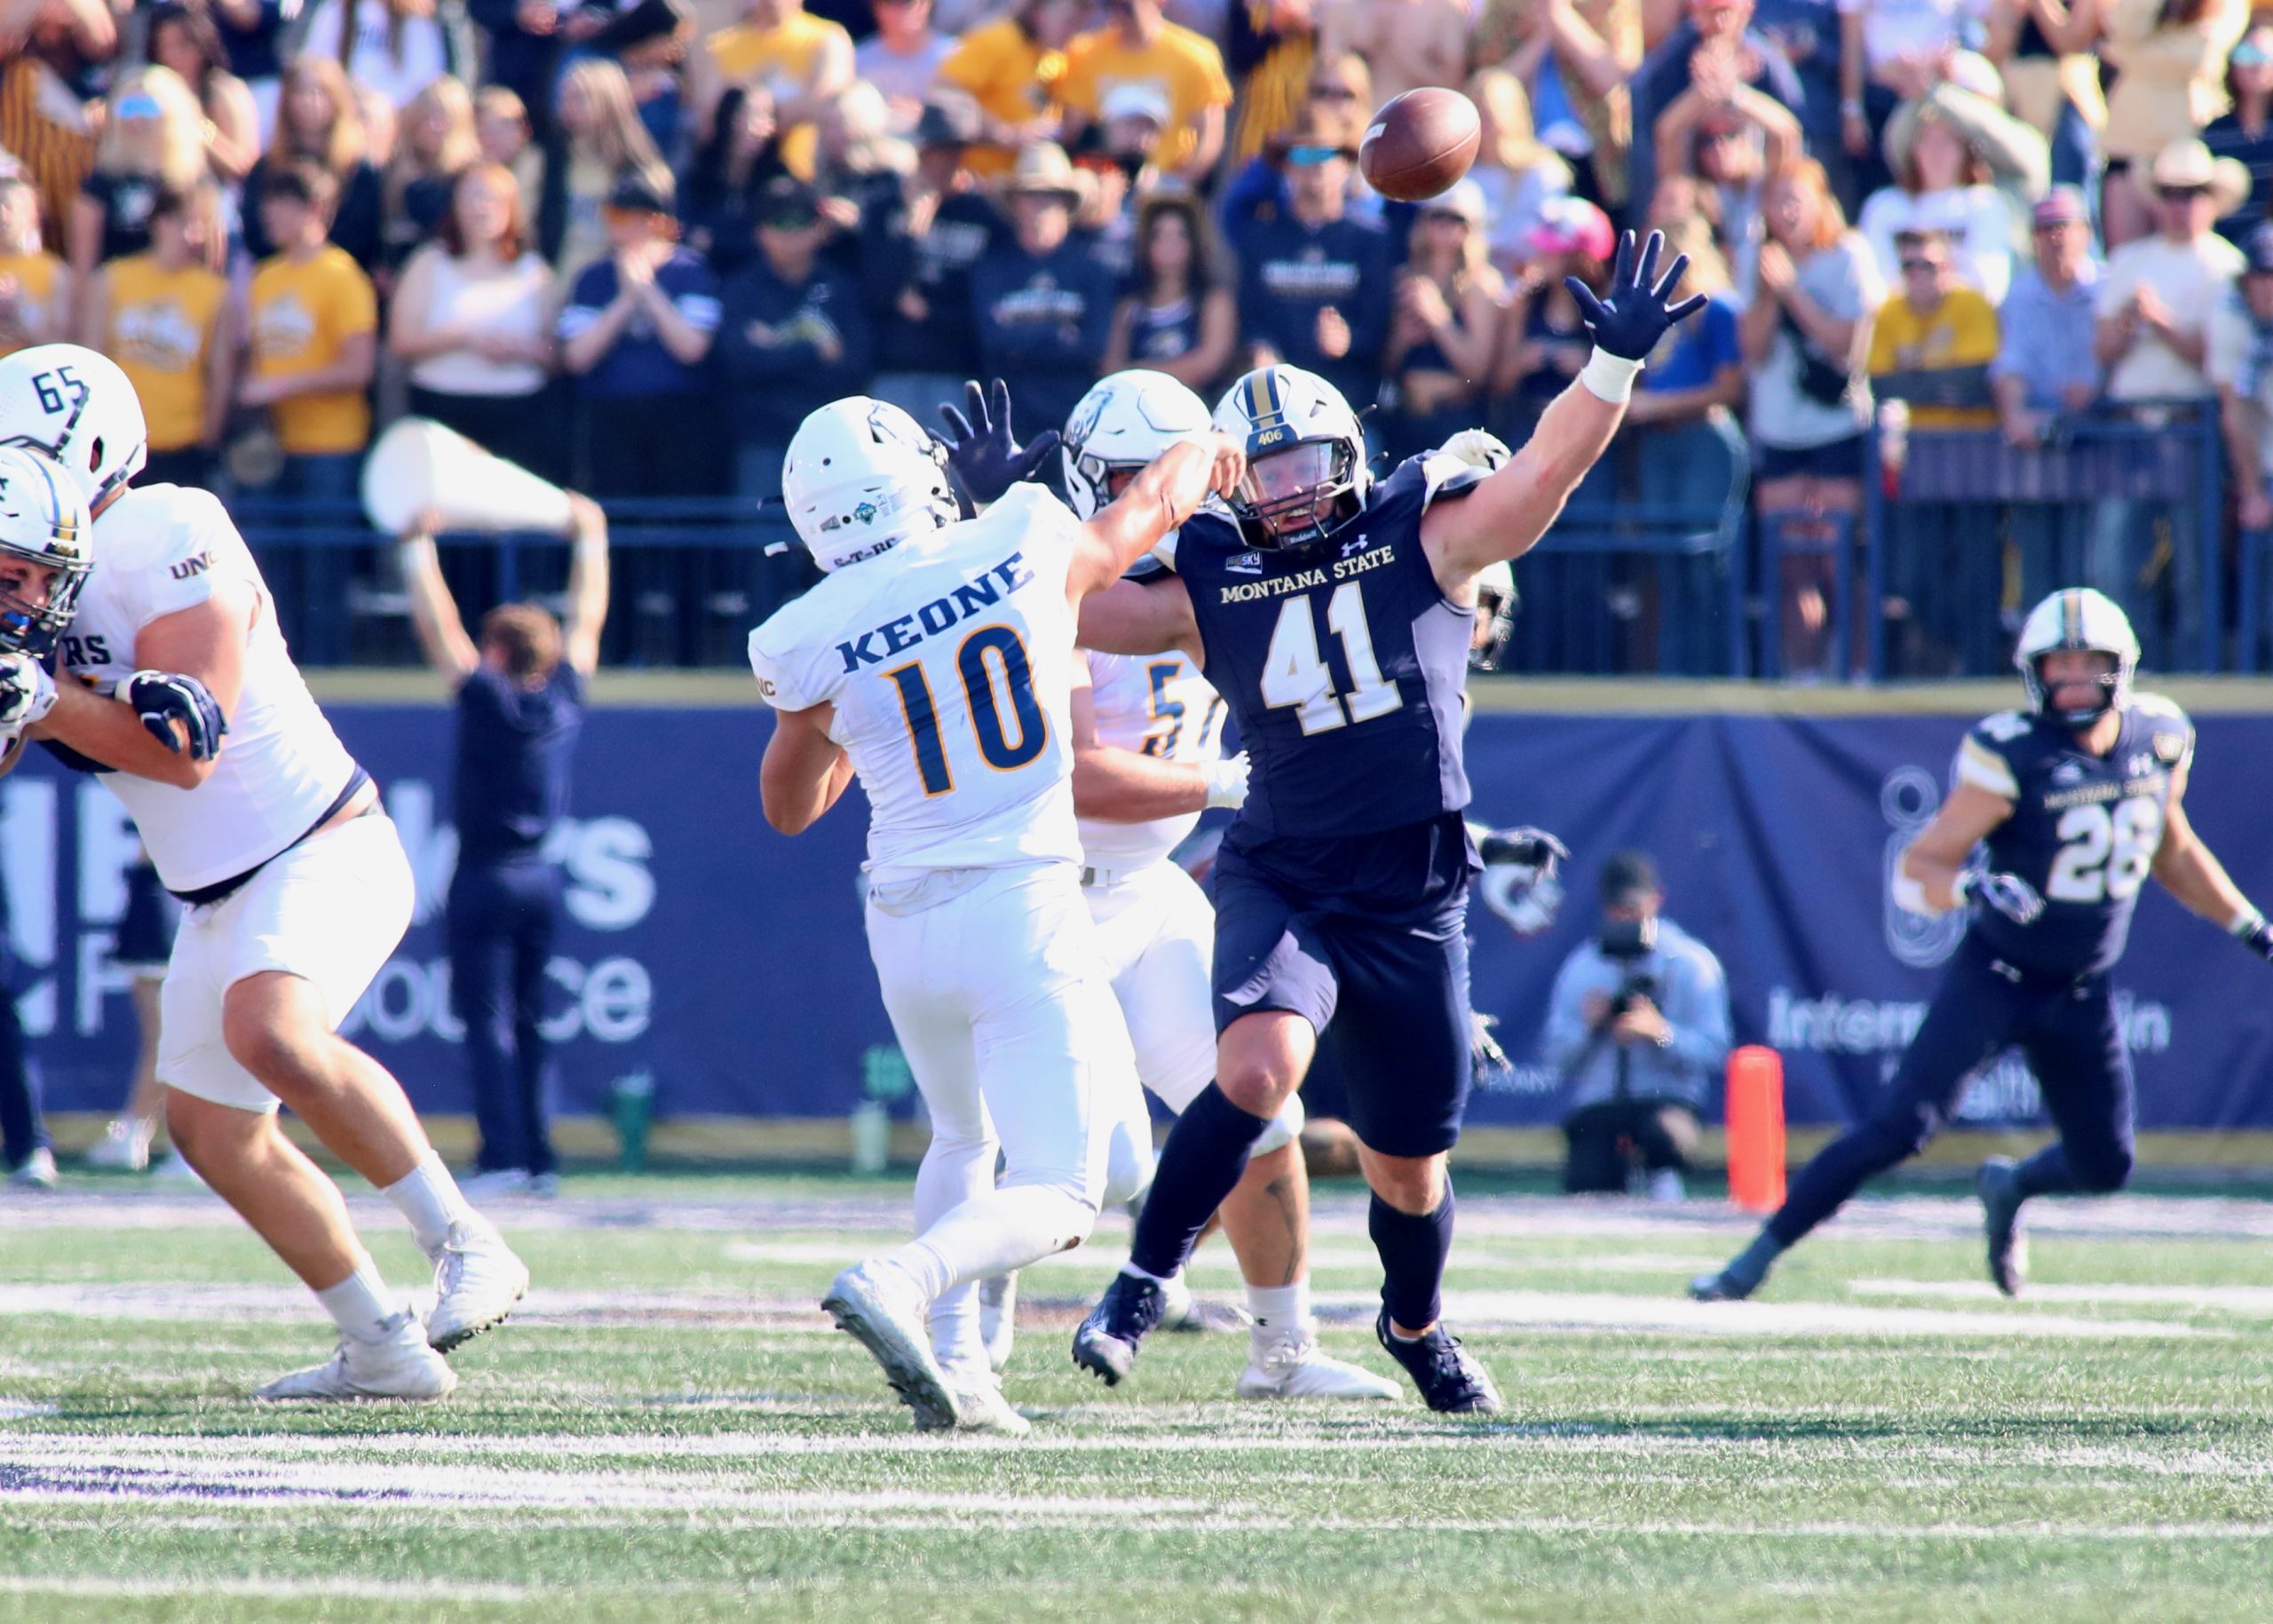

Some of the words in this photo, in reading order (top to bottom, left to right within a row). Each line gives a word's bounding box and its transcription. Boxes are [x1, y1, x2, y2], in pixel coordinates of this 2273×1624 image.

[31, 366, 89, 414] 65
[1257, 428, 1283, 445] 406
[835, 551, 1036, 674] KEONE
[1220, 568, 1328, 604] MONTANA
[1333, 544, 1396, 579] STATE
[1260, 580, 1404, 737] 41
[880, 622, 1050, 798] 10
